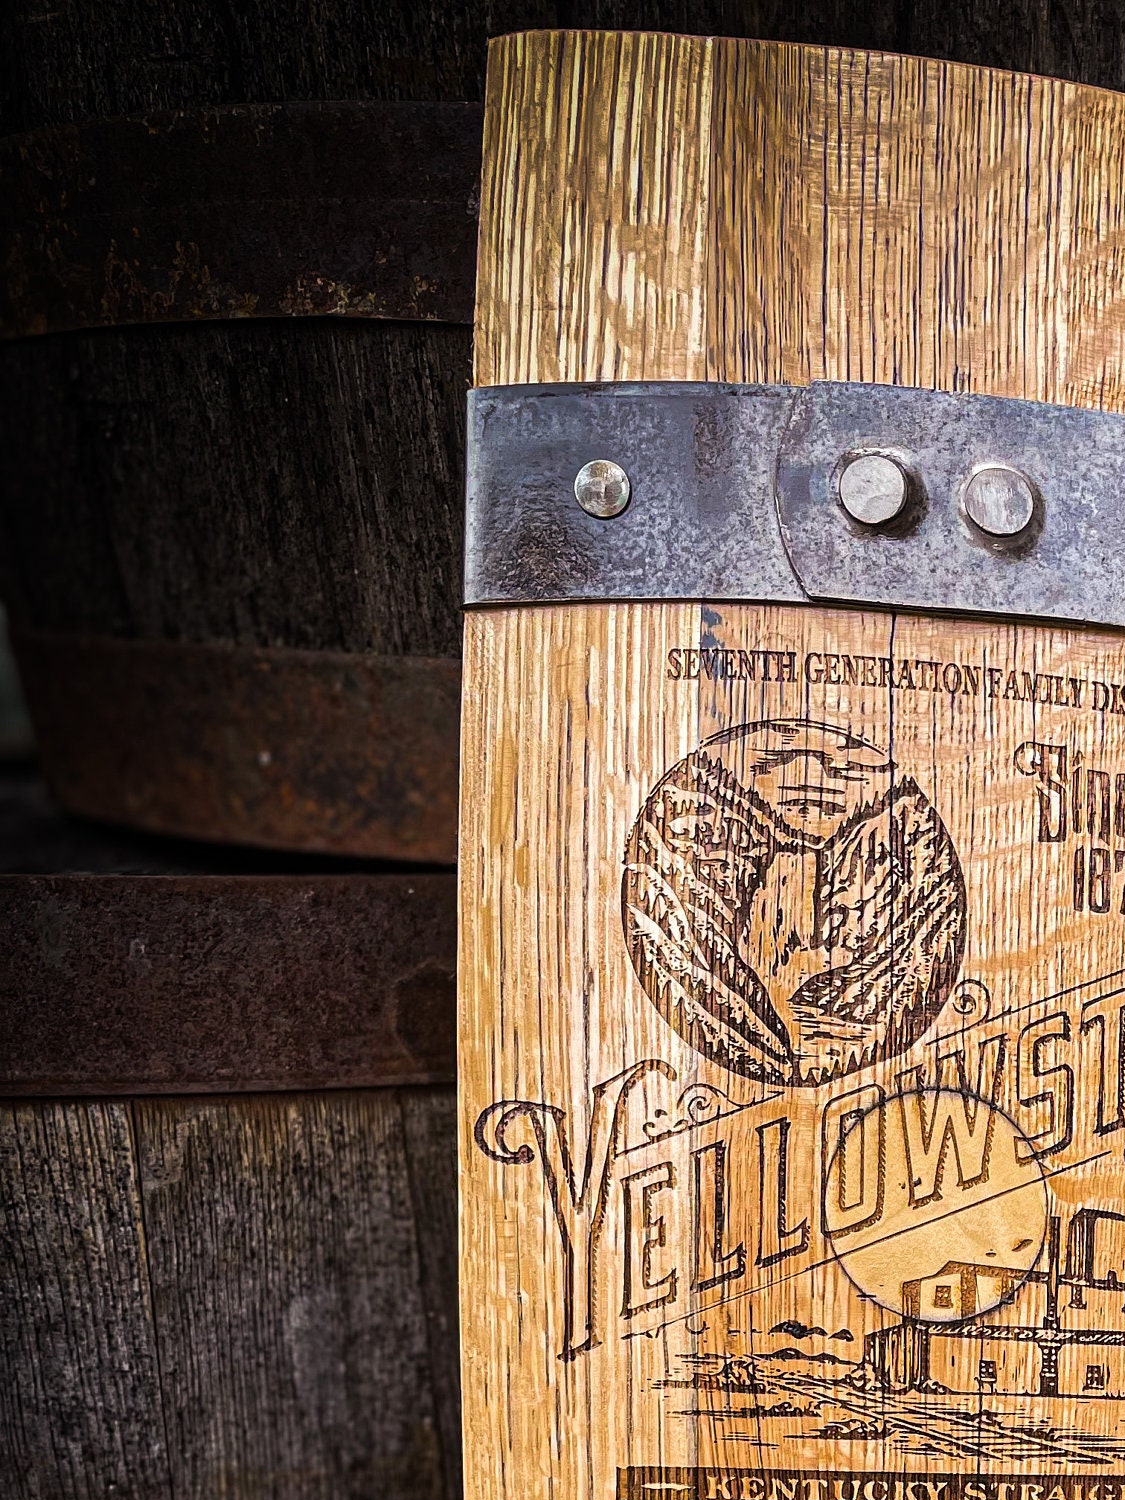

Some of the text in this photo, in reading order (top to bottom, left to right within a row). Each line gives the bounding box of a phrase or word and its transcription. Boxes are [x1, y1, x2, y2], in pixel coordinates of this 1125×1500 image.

[667, 648, 796, 683] SEVENTH
[805, 650, 981, 697] GENERATION
[986, 667, 1086, 709] FAMILY
